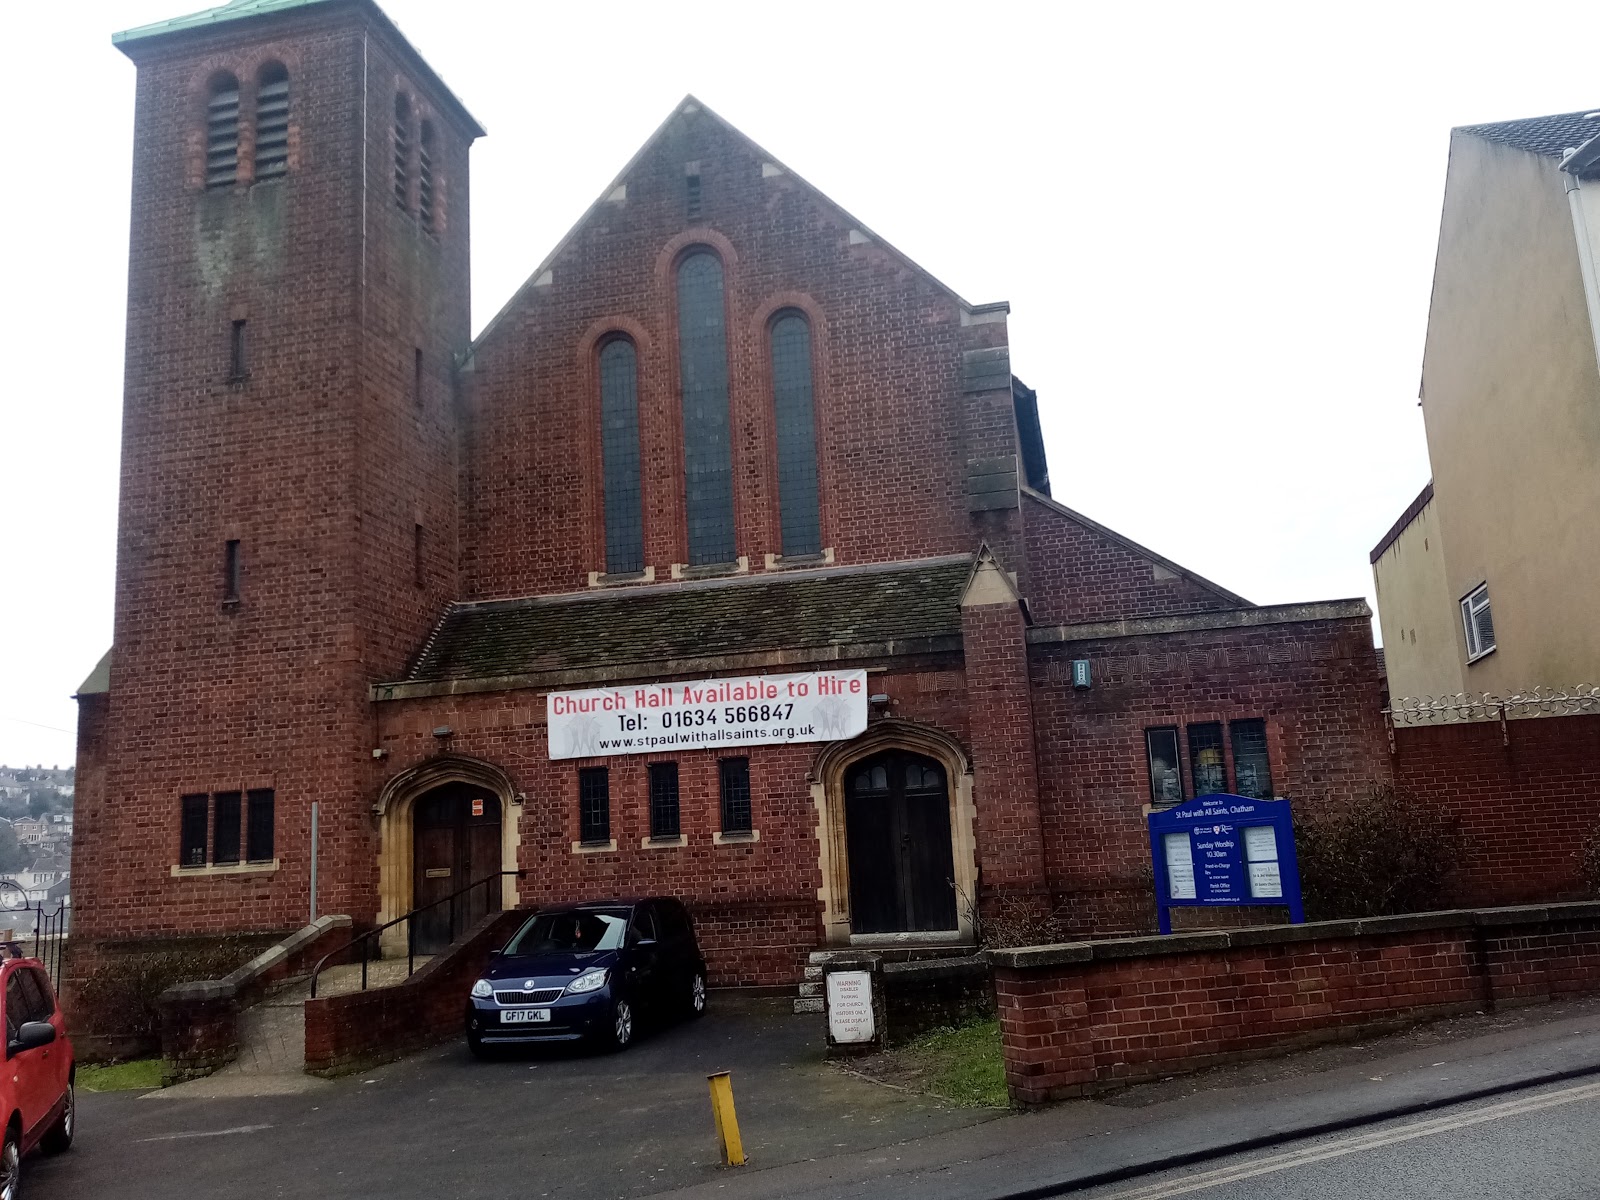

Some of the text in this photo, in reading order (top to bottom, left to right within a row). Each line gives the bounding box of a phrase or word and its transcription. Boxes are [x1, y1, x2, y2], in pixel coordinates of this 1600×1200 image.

[553, 675, 861, 715] Church Hall Available to Hire
[618, 703, 794, 731] Tel: 01634 566847
[599, 724, 816, 749] www.stpaulwithallsaints.org.uk
[1182, 810, 1192, 818] Paul
[1193, 808, 1204, 817] with
[1205, 807, 1213, 816] All
[1212, 806, 1230, 816] Saints,
[1230, 804, 1254, 814] Chatham
[1197, 840, 1234, 850] Sunday Worship
[1206, 850, 1227, 858] 10.30am
[505, 1010, 545, 1021] GF17 GKL
